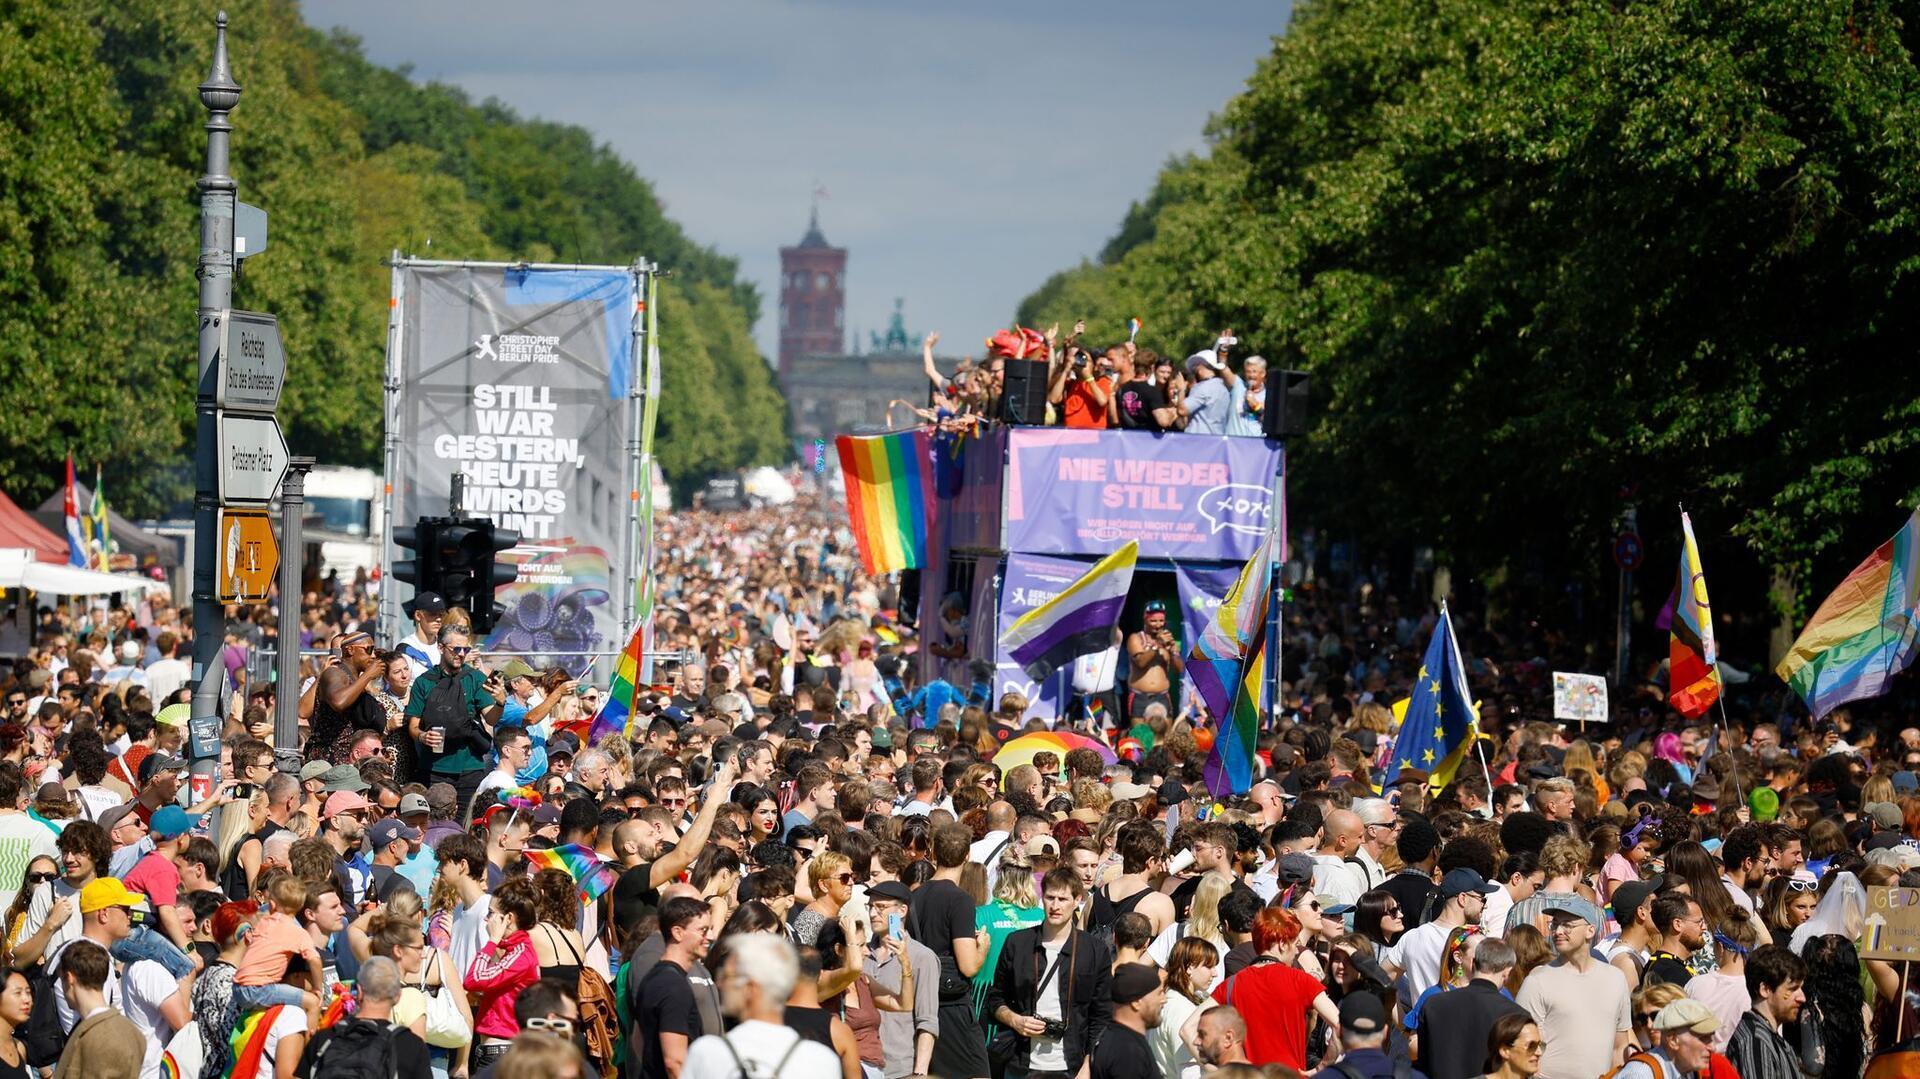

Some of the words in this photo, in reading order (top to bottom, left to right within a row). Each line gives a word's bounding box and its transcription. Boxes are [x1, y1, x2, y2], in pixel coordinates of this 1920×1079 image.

[241, 331, 265, 366] Reichstag
[499, 334, 560, 346] CHRISTOPHER
[499, 344, 534, 354] STREET
[534, 345, 553, 354] DAY
[499, 352, 531, 363] BERLIN
[532, 353, 560, 364] PRIDE
[473, 384, 557, 411] STILL
[475, 409, 554, 437] WAR
[232, 445, 257, 471] Potsdamer
[258, 446, 273, 472] Platz
[434, 433, 586, 469] GESTERN,
[461, 461, 558, 487] HEUTE
[1058, 456, 1107, 482] NIE
[1114, 458, 1229, 487] WIEDER
[462, 486, 567, 514] WIRDS
[1102, 483, 1184, 512] STILL
[468, 512, 555, 539] UNT
